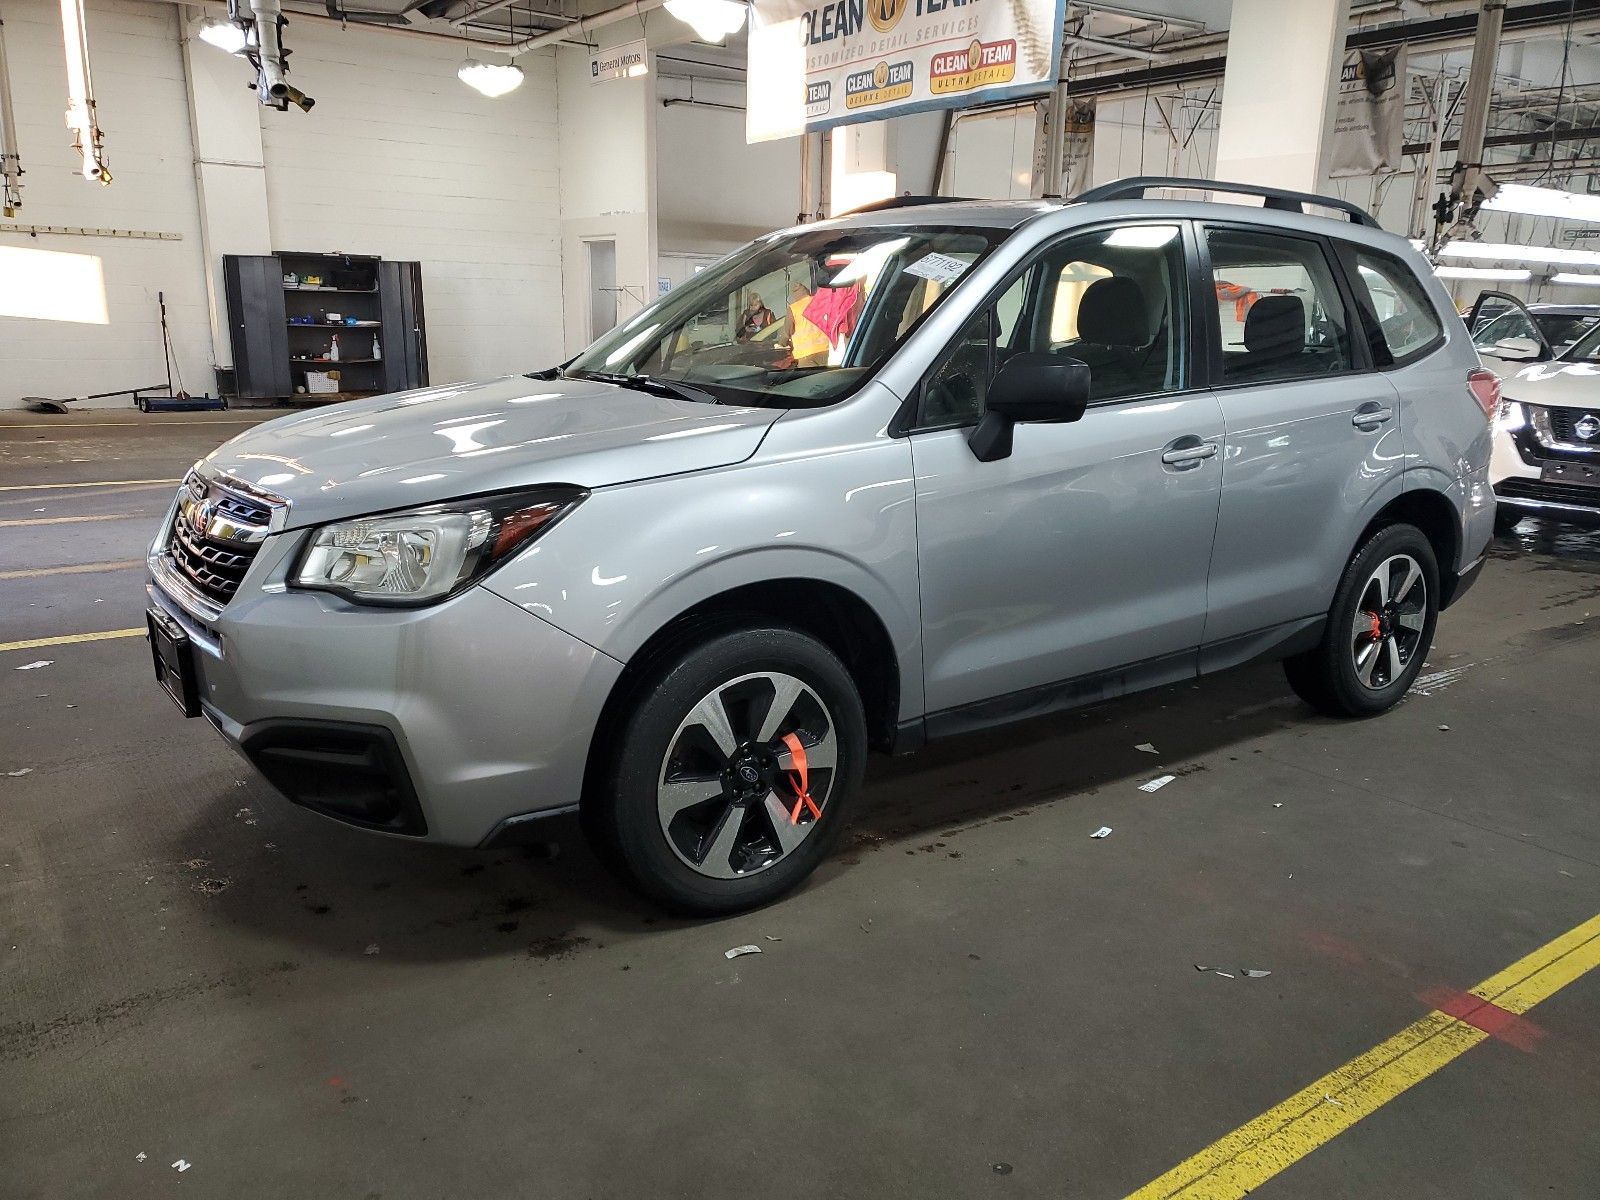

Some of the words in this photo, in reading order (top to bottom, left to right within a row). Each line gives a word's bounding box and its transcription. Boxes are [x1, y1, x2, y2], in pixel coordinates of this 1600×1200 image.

[800, 0, 864, 47] CLEAN
[806, 45, 863, 69] STOMIZED
[871, 33, 908, 53] DETAIL
[916, 15, 979, 41] SERVICES
[934, 54, 968, 74] CLEAN
[982, 44, 1012, 64] TEAM
[847, 72, 873, 92] CLEAN
[889, 64, 911, 83] TEAM
[938, 75, 970, 88] ULTRA
[974, 67, 1006, 82] DETAIL
[808, 83, 829, 101] TEAM
[849, 92, 879, 105] DELUXE
[883, 86, 908, 98] DETAIL
[806, 104, 826, 115] ETAIL
